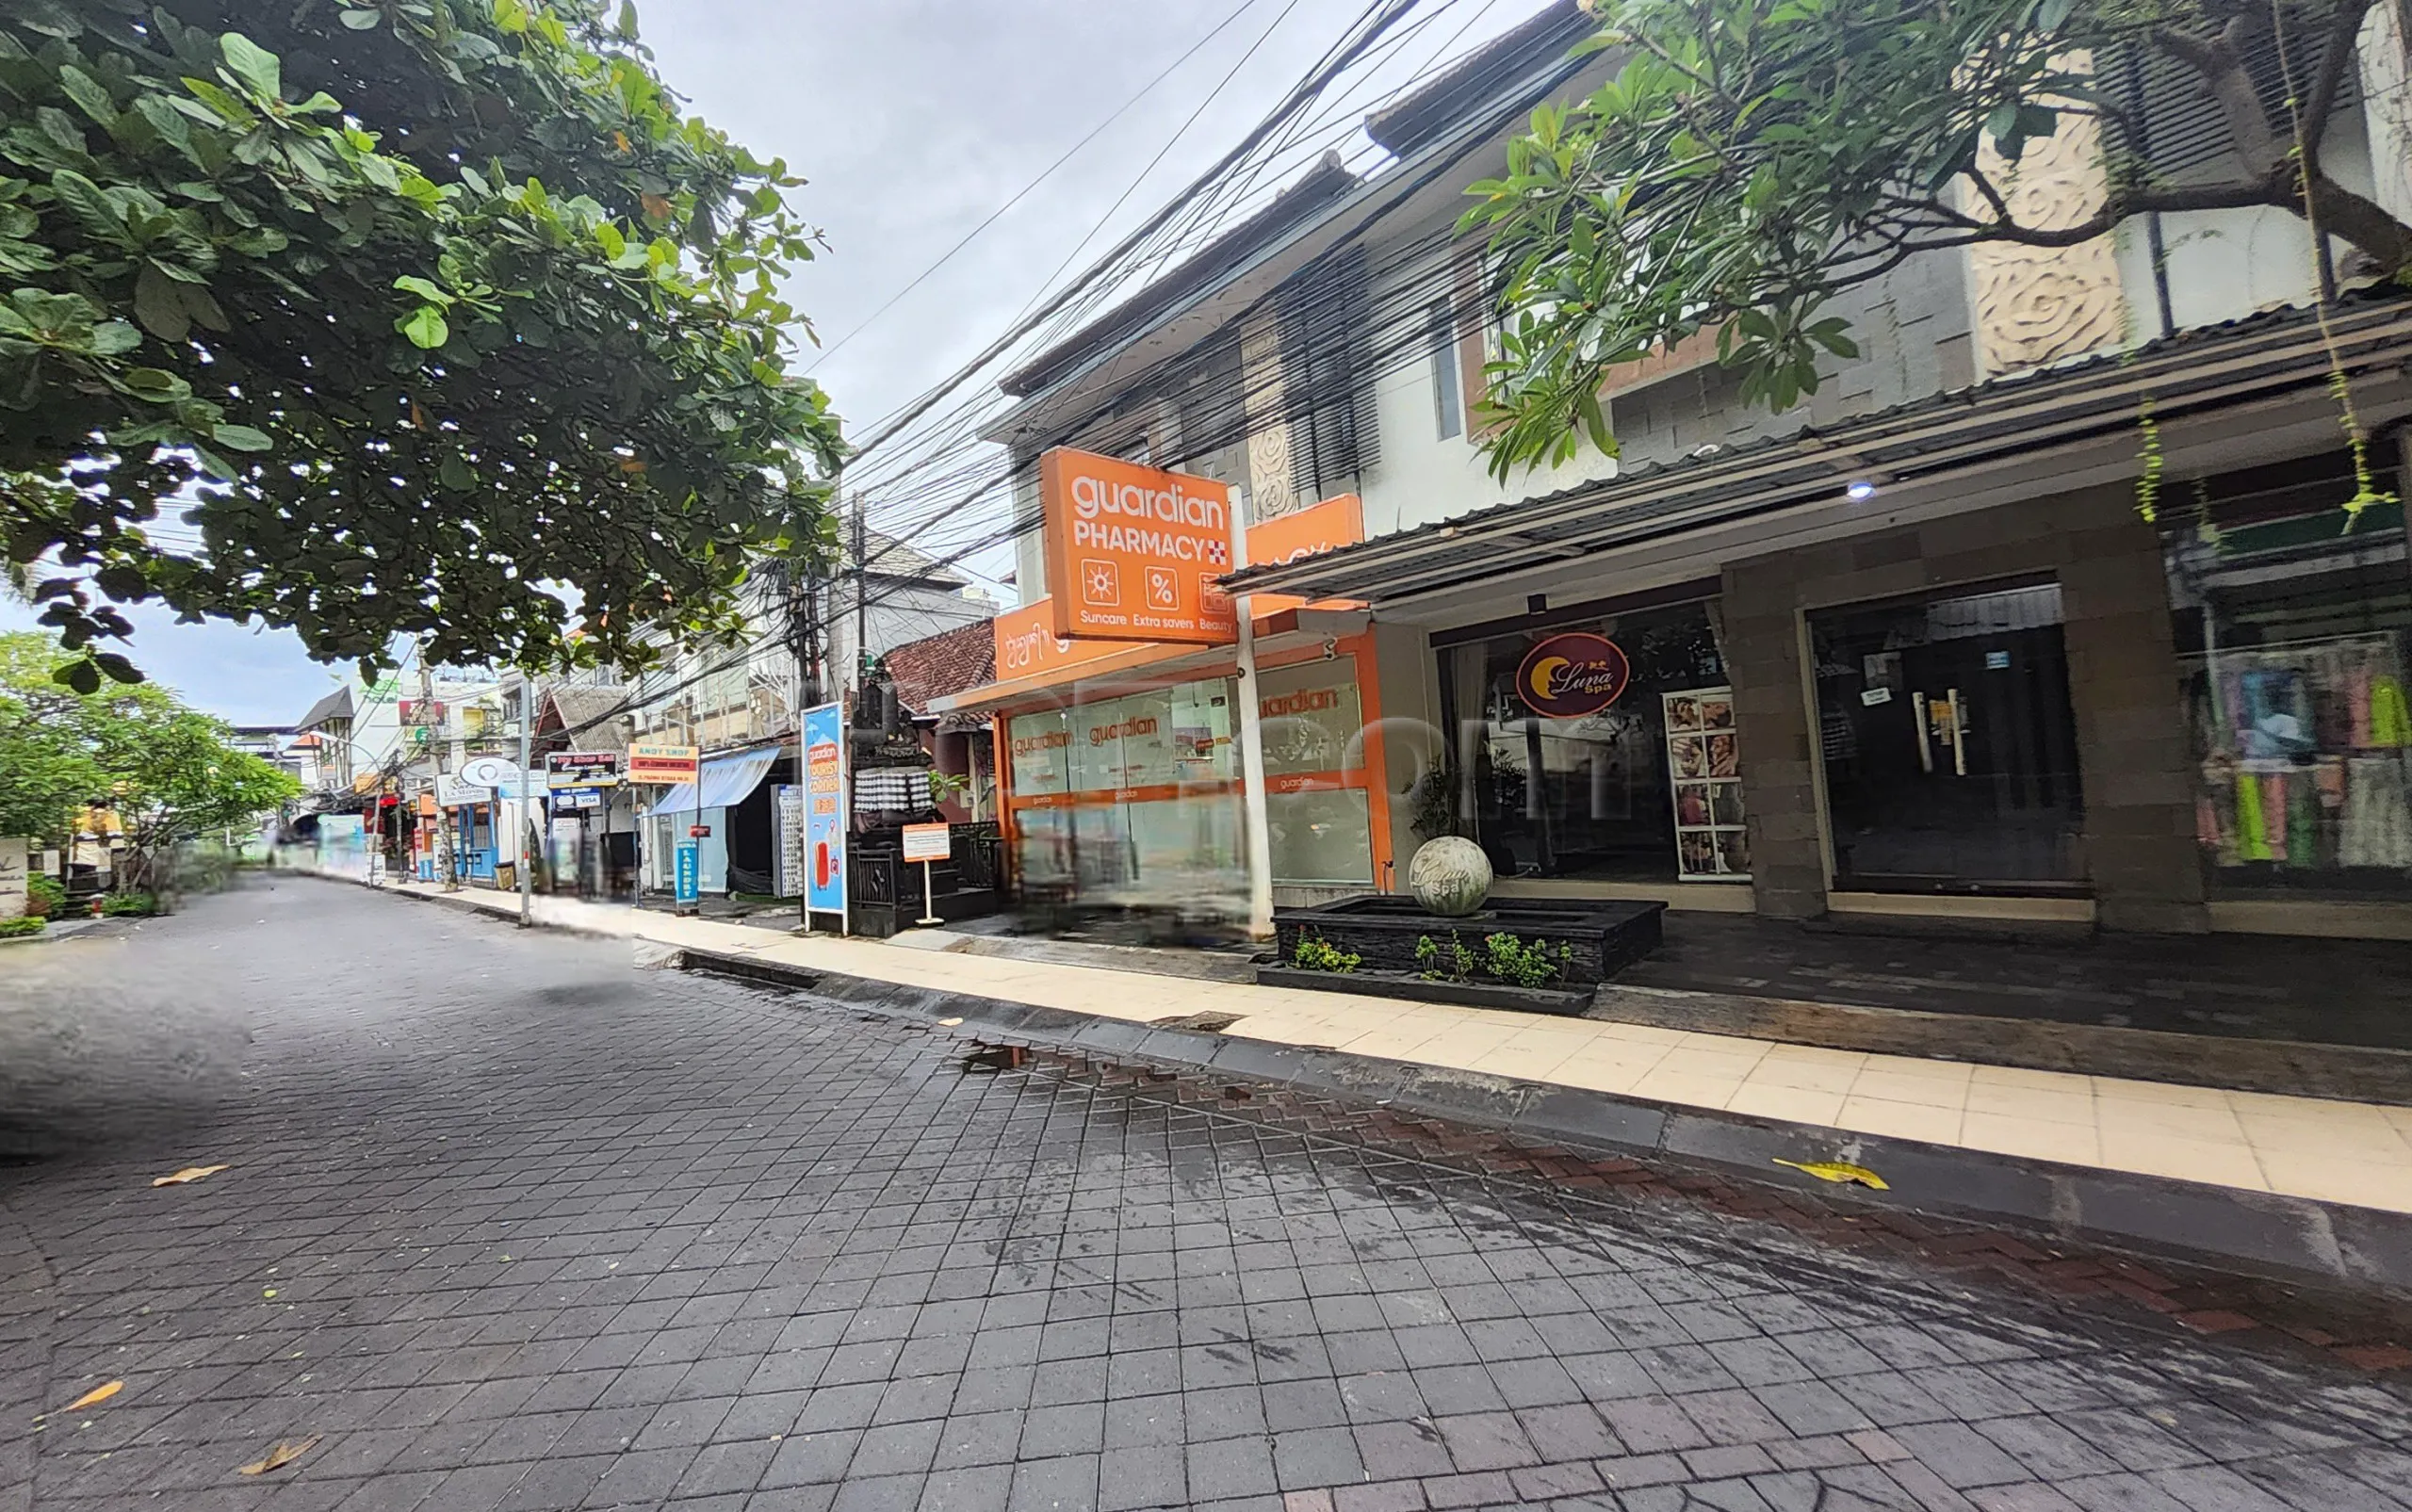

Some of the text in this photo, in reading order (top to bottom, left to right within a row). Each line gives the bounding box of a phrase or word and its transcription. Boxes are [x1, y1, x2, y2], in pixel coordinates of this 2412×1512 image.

[1071, 475, 1224, 530] guardian
[1074, 520, 1204, 561] PHARMACY
[1080, 610, 1127, 626] Suncare
[1133, 612, 1195, 630] Extra savers
[1198, 618, 1233, 634] Beauty
[1551, 661, 1613, 694] Luna
[1584, 682, 1612, 695] Spa
[1259, 688, 1338, 719] uardian
[1089, 716, 1158, 747] guardian
[1280, 776, 1314, 789] guardian
[1431, 882, 1459, 896] Spa
